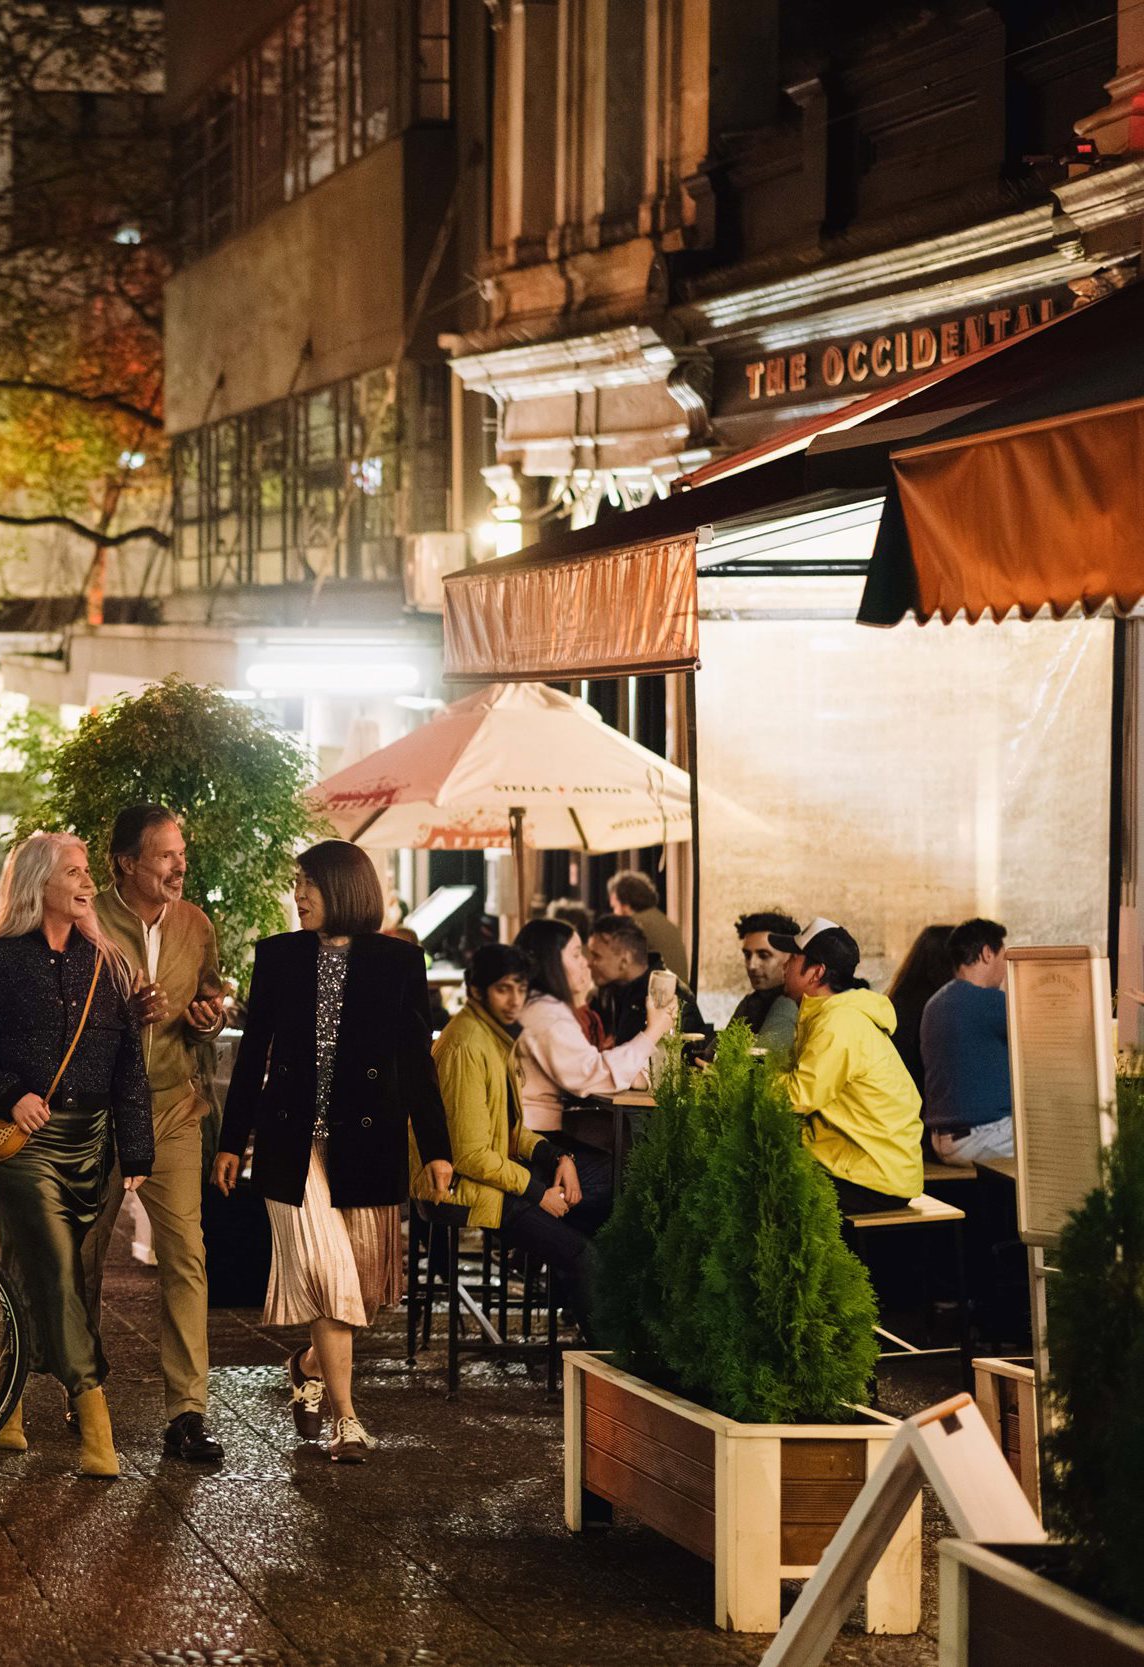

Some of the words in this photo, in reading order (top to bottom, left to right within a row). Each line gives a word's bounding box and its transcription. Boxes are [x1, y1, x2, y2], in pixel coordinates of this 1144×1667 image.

[745, 352, 806, 400] THE
[493, 784, 552, 794] STELLA
[572, 786, 632, 795] ARTOIS
